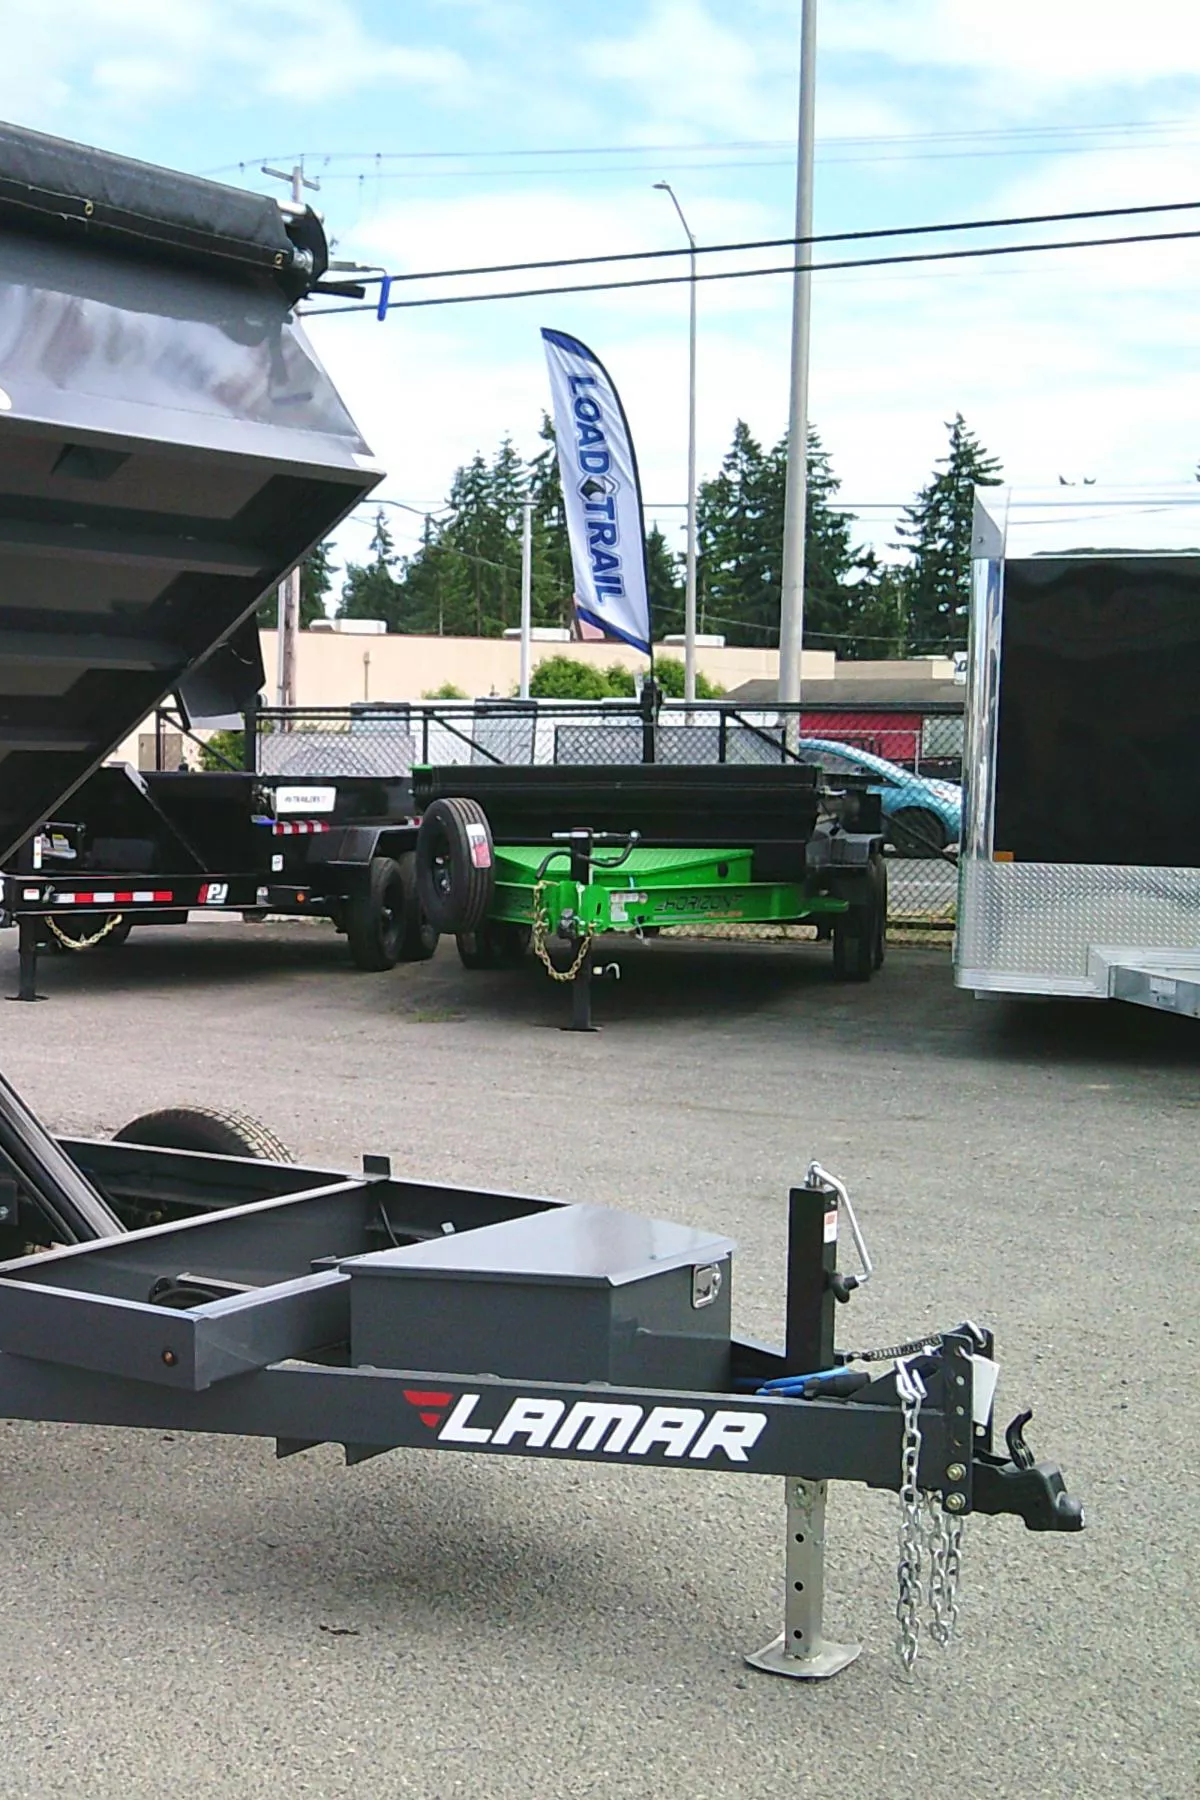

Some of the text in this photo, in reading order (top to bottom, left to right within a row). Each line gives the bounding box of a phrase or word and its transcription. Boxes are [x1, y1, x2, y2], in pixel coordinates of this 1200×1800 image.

[568, 375, 624, 603] LOAD TRAIL
[206, 883, 229, 900] PJ
[438, 1394, 768, 1462] LAMAR
